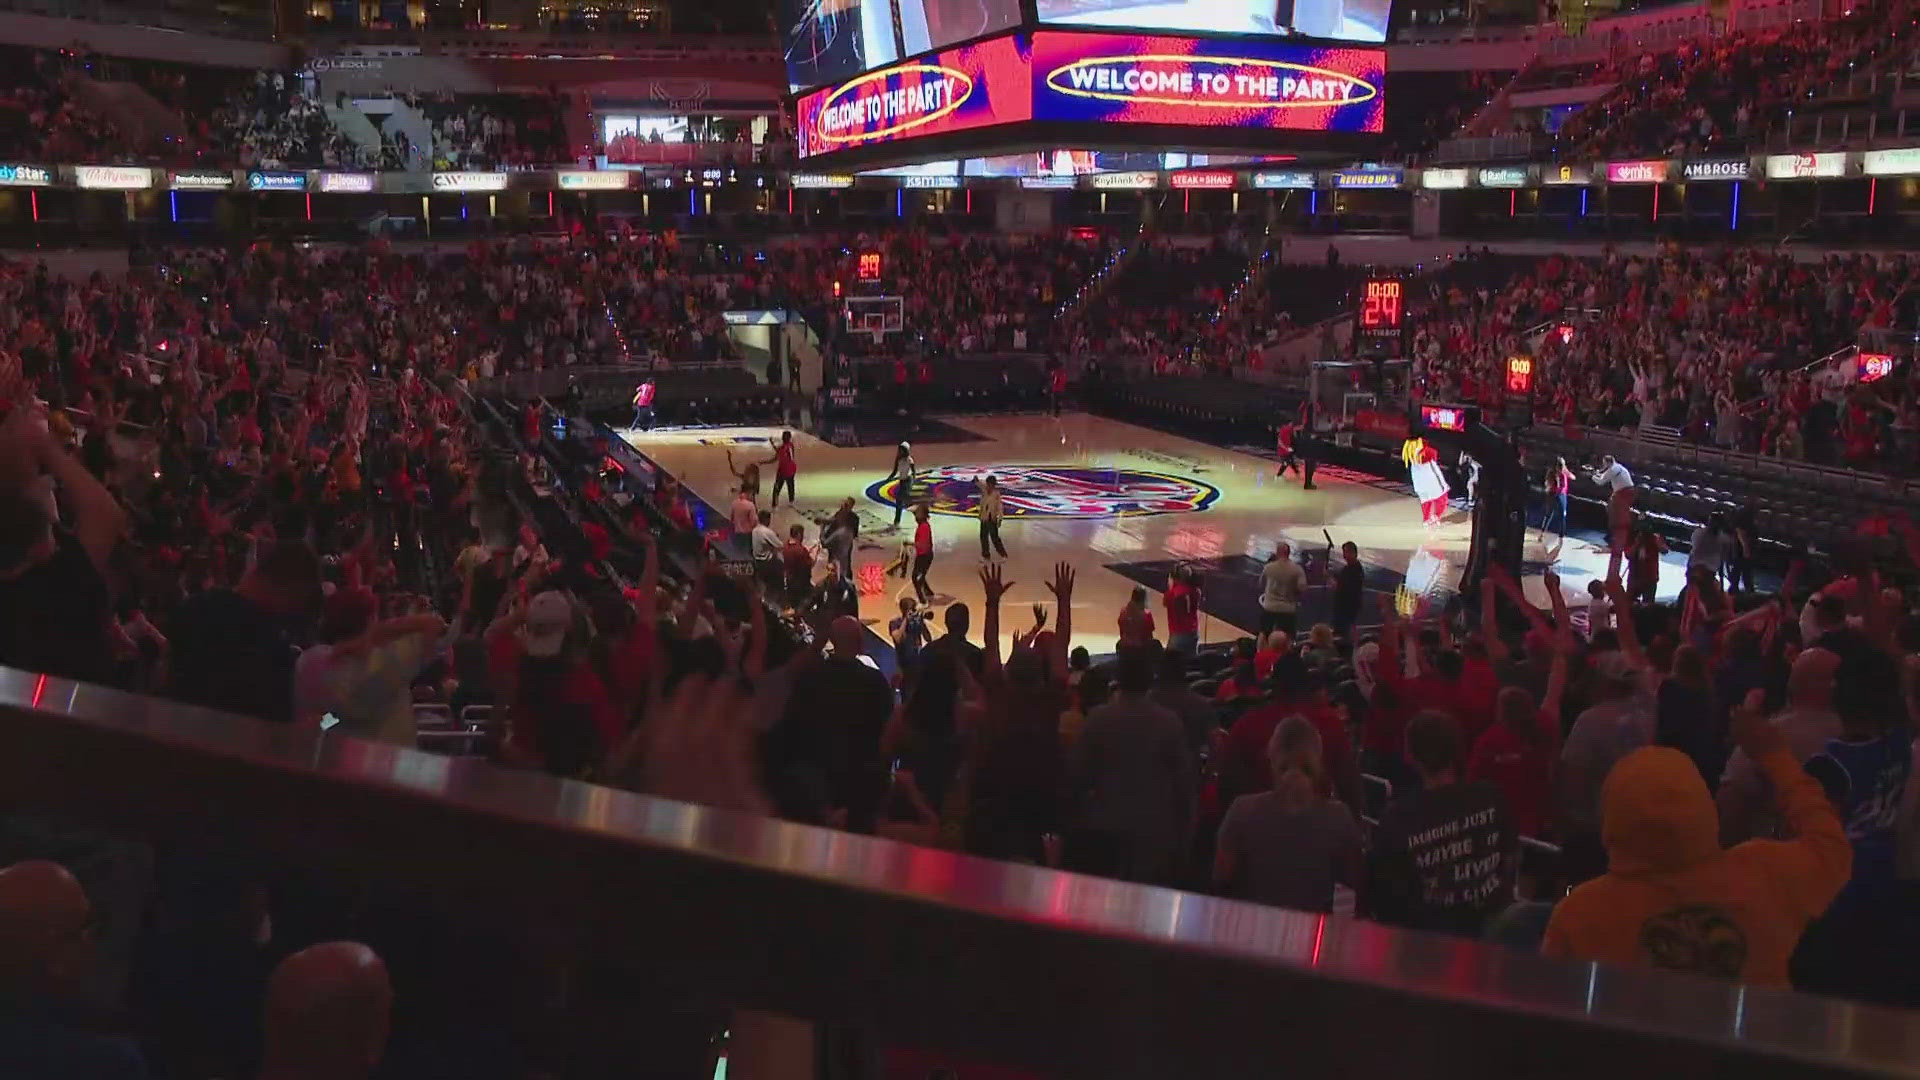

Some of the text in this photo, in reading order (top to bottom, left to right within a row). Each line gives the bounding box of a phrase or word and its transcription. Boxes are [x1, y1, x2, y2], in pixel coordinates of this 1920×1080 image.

[1070, 68, 1353, 102] WELCOME TO THE PARTY
[824, 77, 955, 133] WELCOME TO THE PARTY
[1172, 175, 1198, 185] STEAK
[1205, 175, 1233, 185] SHAKE
[1340, 175, 1387, 184] REVVED UP
[1630, 165, 1653, 179] mhs
[1684, 162, 1746, 177] AMBROSE
[1367, 282, 1399, 298] 10:00
[1365, 298, 1397, 325] 24
[1408, 808, 1496, 849] IMAGINE JUST
[1416, 839, 1473, 868] MAYBE
